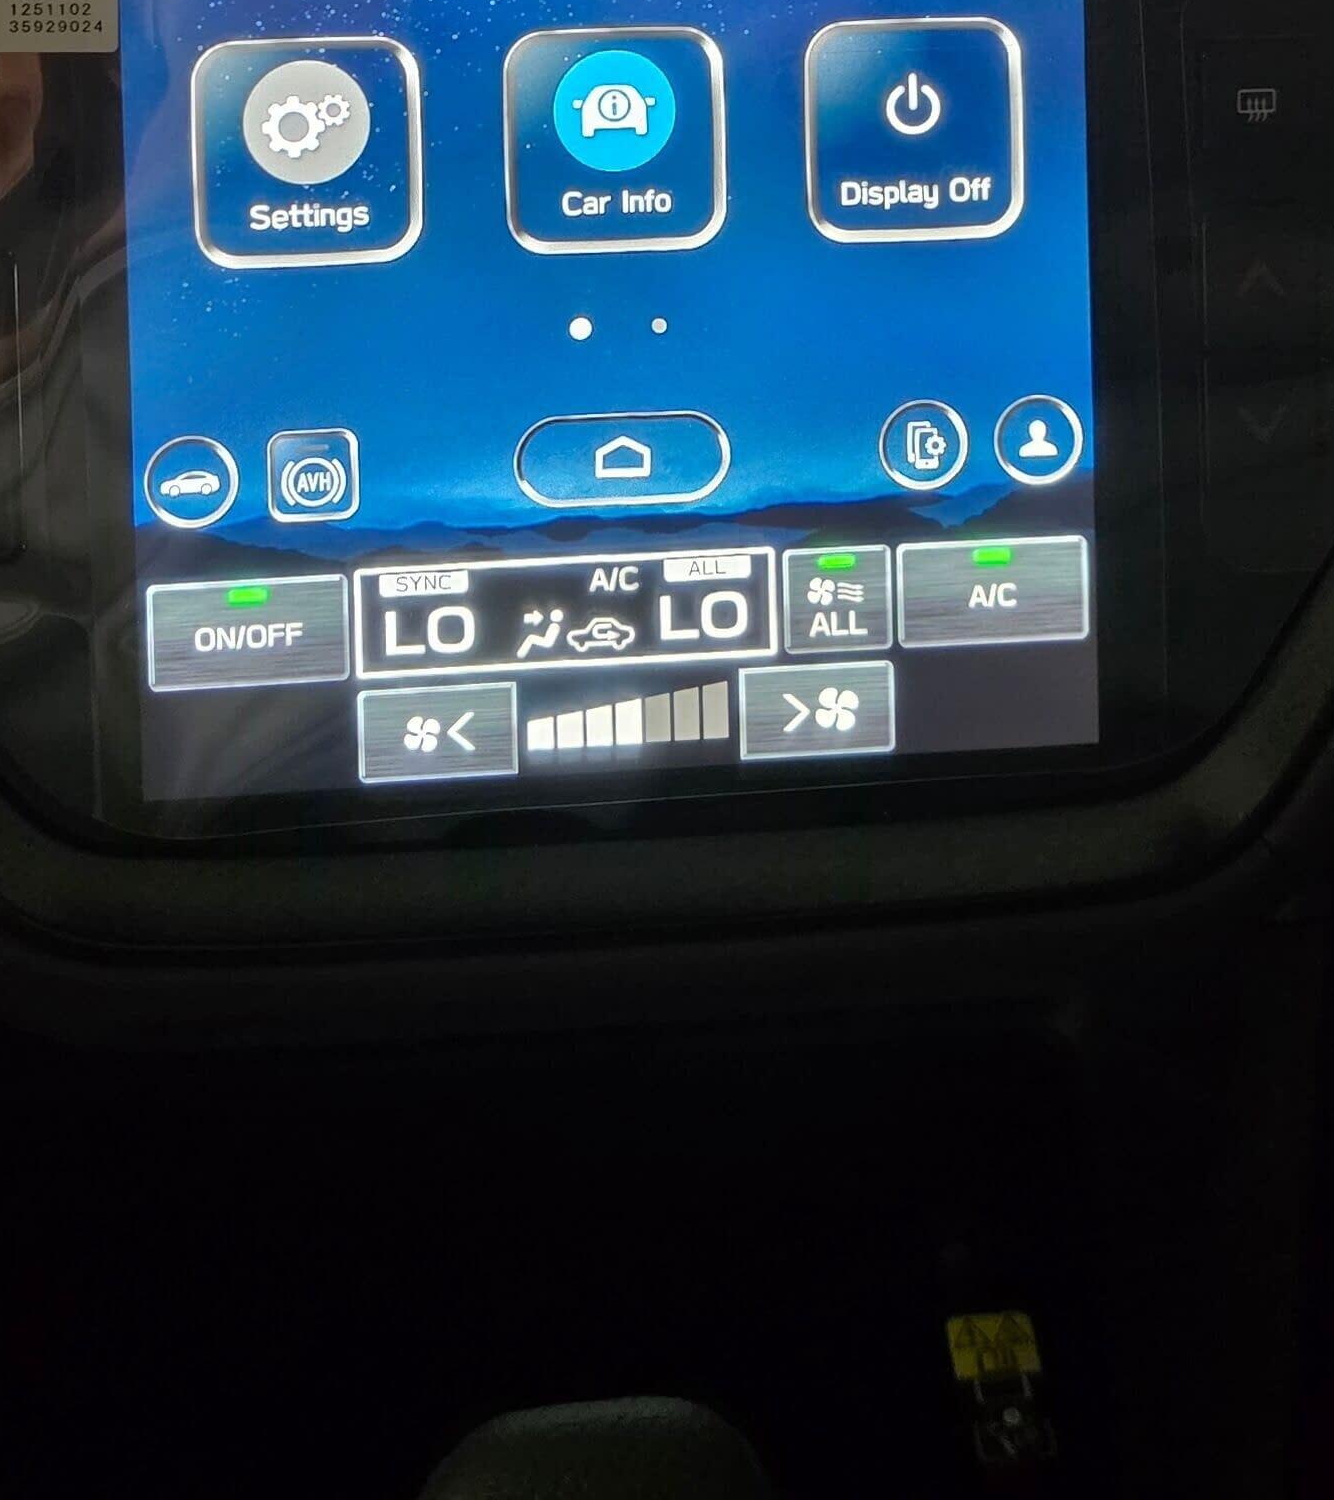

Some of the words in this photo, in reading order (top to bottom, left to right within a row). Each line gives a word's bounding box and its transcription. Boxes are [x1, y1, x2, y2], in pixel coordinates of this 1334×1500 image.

[10, 3, 92, 16] 1251102
[9, 20, 104, 33] 35929024
[561, 190, 612, 217] Car
[621, 188, 673, 214] Info
[840, 179, 939, 210] Display
[949, 176, 992, 203] Off
[249, 203, 370, 233] Settings
[297, 471, 332, 493] AVH
[589, 566, 640, 593] A/C
[688, 560, 727, 577] ALL
[395, 573, 452, 593] SYNC
[968, 582, 1018, 609] A/C
[659, 591, 749, 641] LO
[809, 609, 868, 638] ALL
[194, 621, 304, 652] ON/OFF
[385, 606, 476, 656] LO
